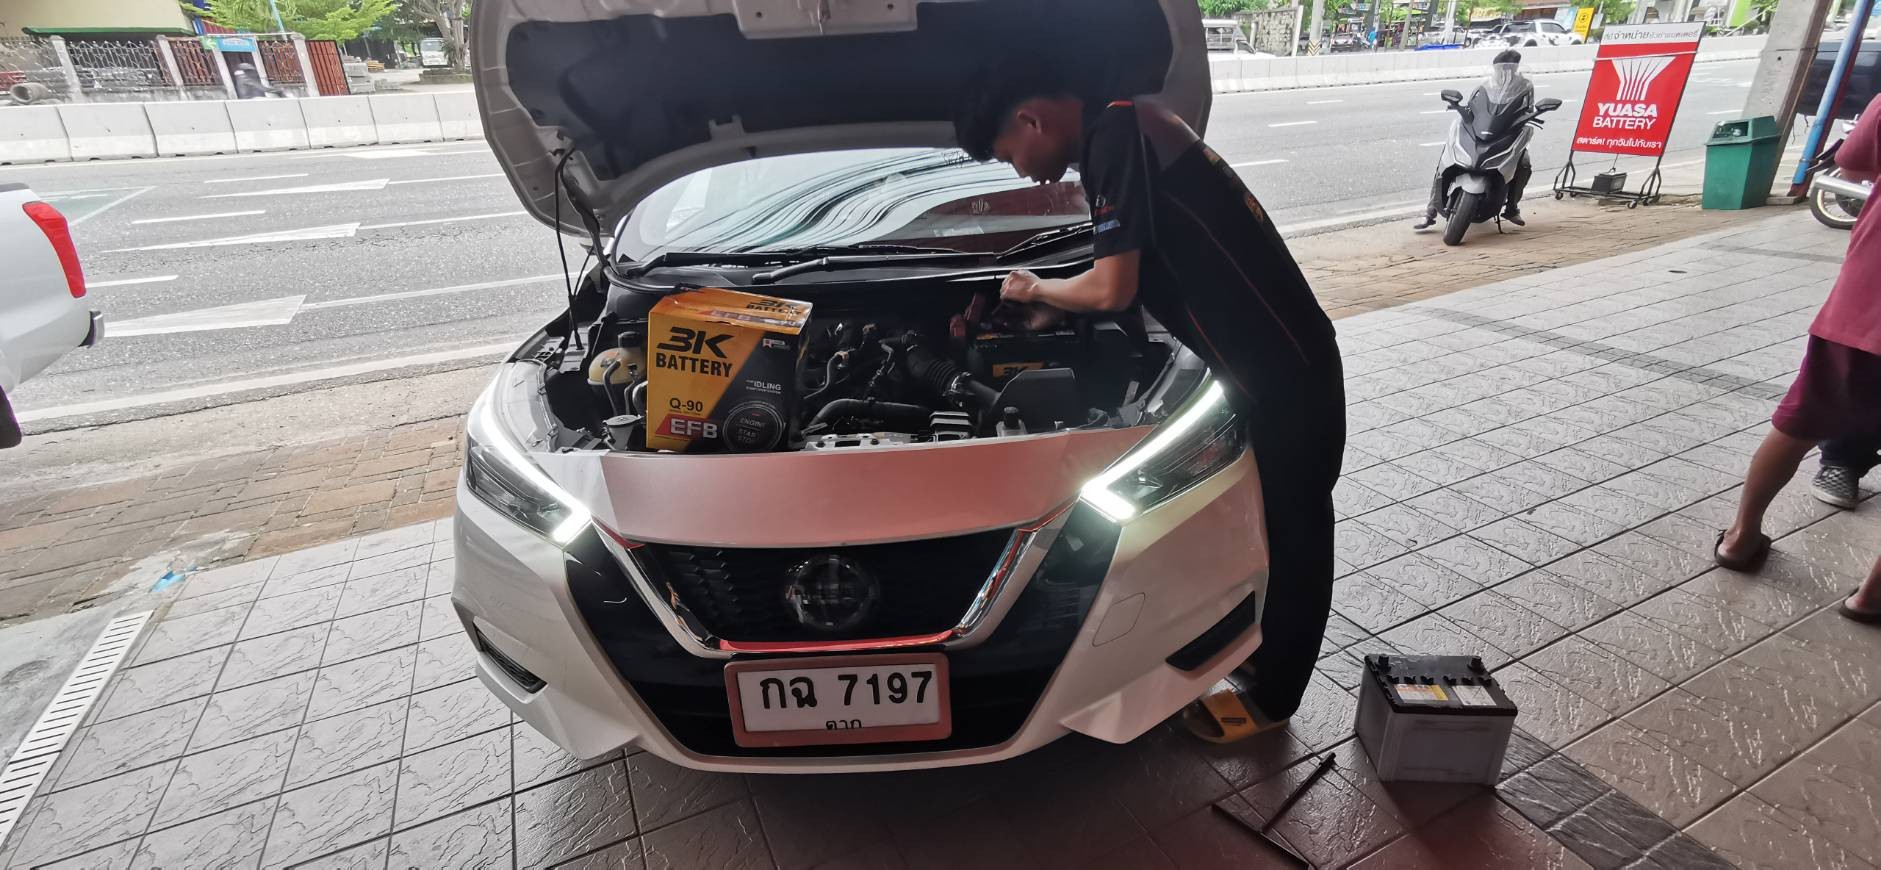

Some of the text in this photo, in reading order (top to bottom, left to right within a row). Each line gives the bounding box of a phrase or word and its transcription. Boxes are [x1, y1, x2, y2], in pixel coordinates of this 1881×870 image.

[1597, 103, 1658, 117] YUASA
[1592, 117, 1656, 130] BATTERY
[656, 326, 734, 359] 3K
[655, 352, 733, 378] BATTERY
[753, 380, 782, 391] IDLING
[669, 397, 703, 412] Q-90
[670, 418, 718, 439] EFB
[759, 670, 932, 709] กฉ 7197
